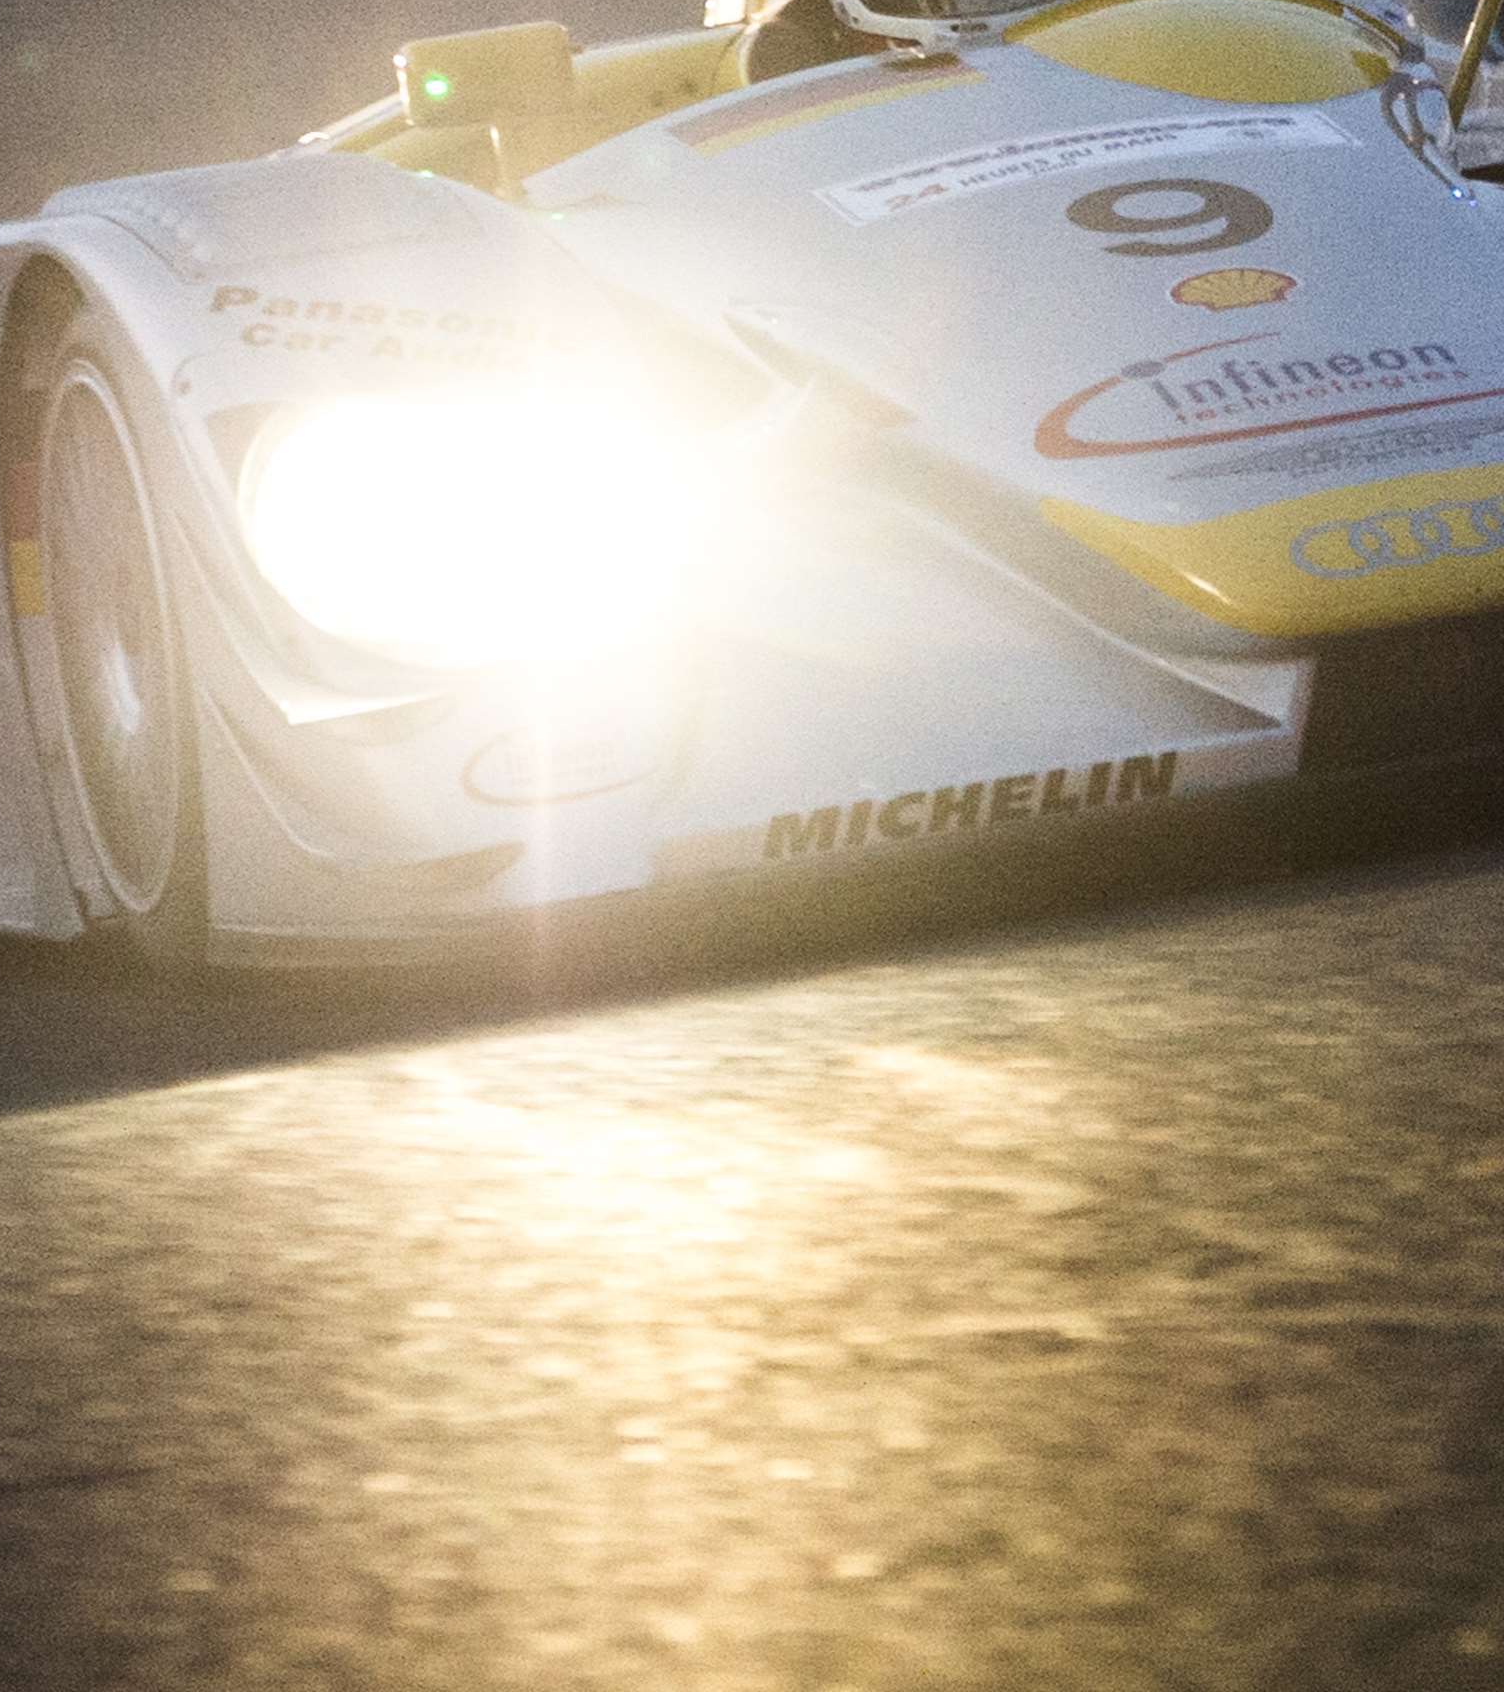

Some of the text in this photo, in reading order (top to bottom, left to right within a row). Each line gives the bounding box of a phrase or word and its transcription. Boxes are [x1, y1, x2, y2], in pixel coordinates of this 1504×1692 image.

[960, 157, 1050, 188] HEURES
[1103, 133, 1179, 152] MANS
[1065, 178, 1274, 257] 9
[209, 285, 562, 350] Panason
[760, 750, 1179, 861] MICHELIN
